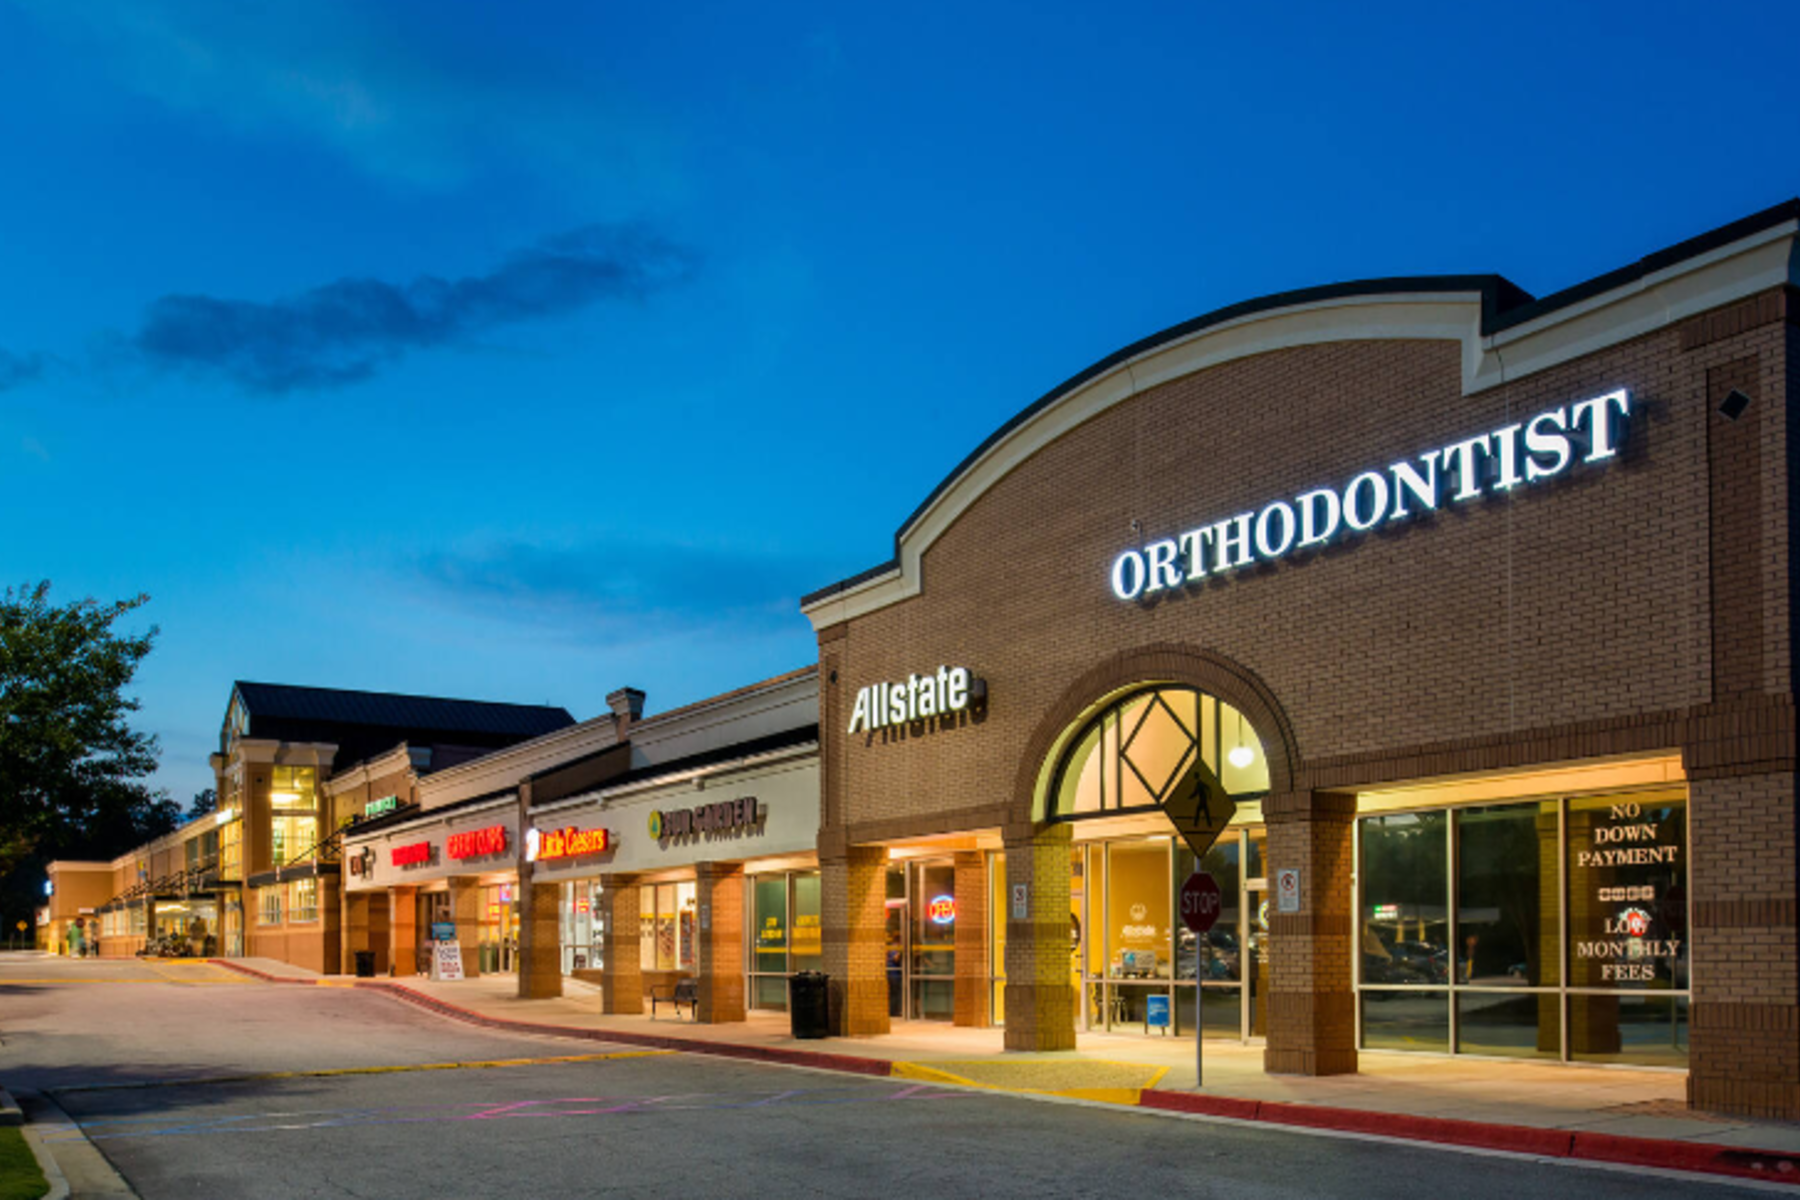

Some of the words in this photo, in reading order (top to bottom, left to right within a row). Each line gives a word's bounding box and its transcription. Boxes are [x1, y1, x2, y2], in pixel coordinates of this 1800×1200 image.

[1112, 388, 1628, 600] ORTHODONTIST
[847, 665, 968, 734] Allstate
[693, 796, 756, 832] GARDEN
[1610, 803, 1641, 820] NO
[1594, 823, 1658, 844] DOWN
[1577, 846, 1678, 867] PAYMENT
[1182, 891, 1218, 914] STOP
[1577, 939, 1680, 959] MONTHLY
[1601, 964, 1655, 981] FEES
